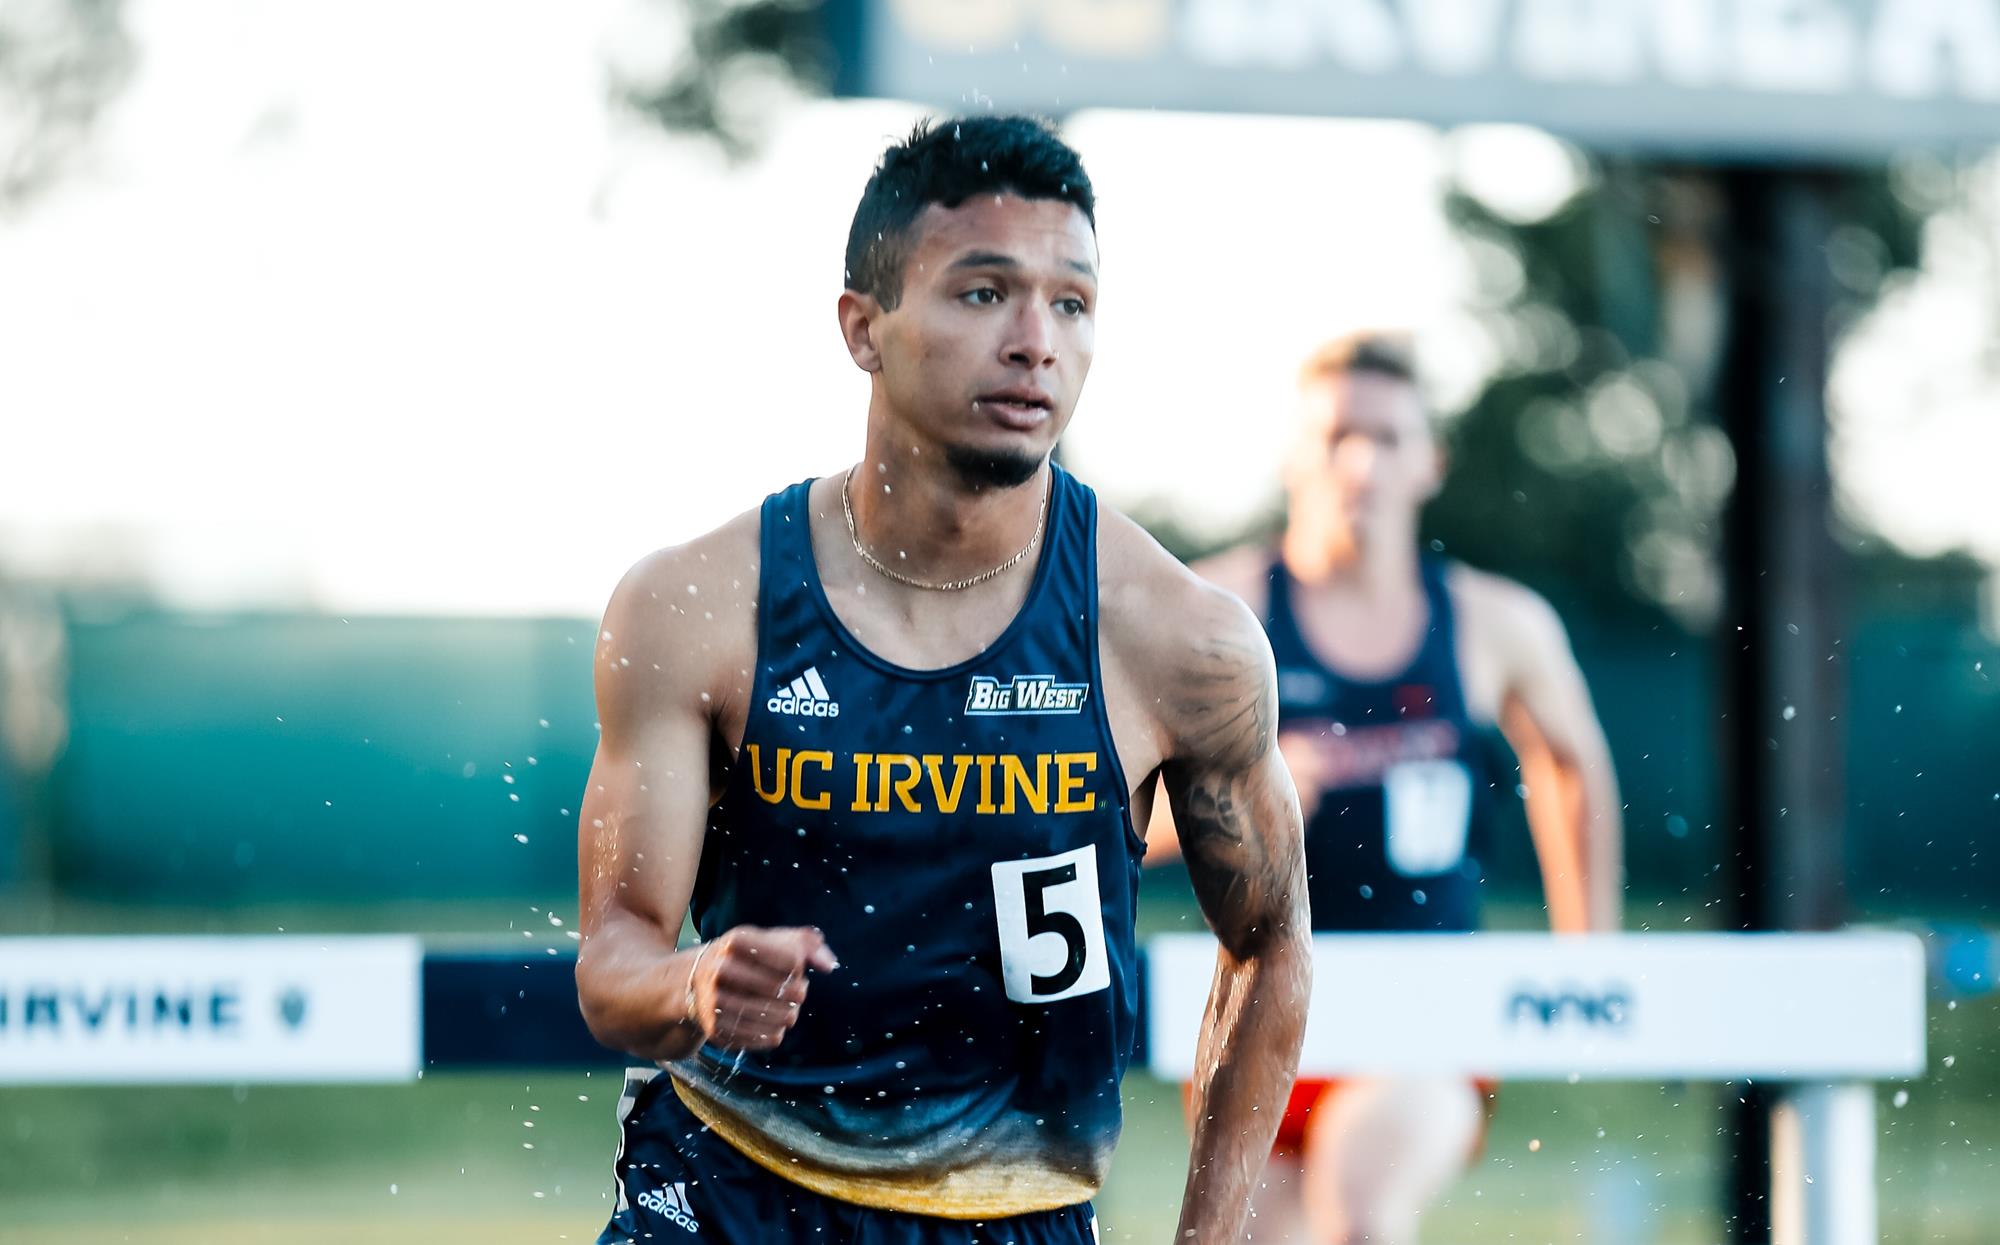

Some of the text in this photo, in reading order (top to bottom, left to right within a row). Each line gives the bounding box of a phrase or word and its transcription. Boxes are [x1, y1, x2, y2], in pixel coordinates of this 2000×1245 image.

[767, 696, 839, 718] adidas
[746, 744, 1097, 814] UC IRVINE
[1022, 863, 1087, 996] 5
[637, 1191, 699, 1233] adidas
